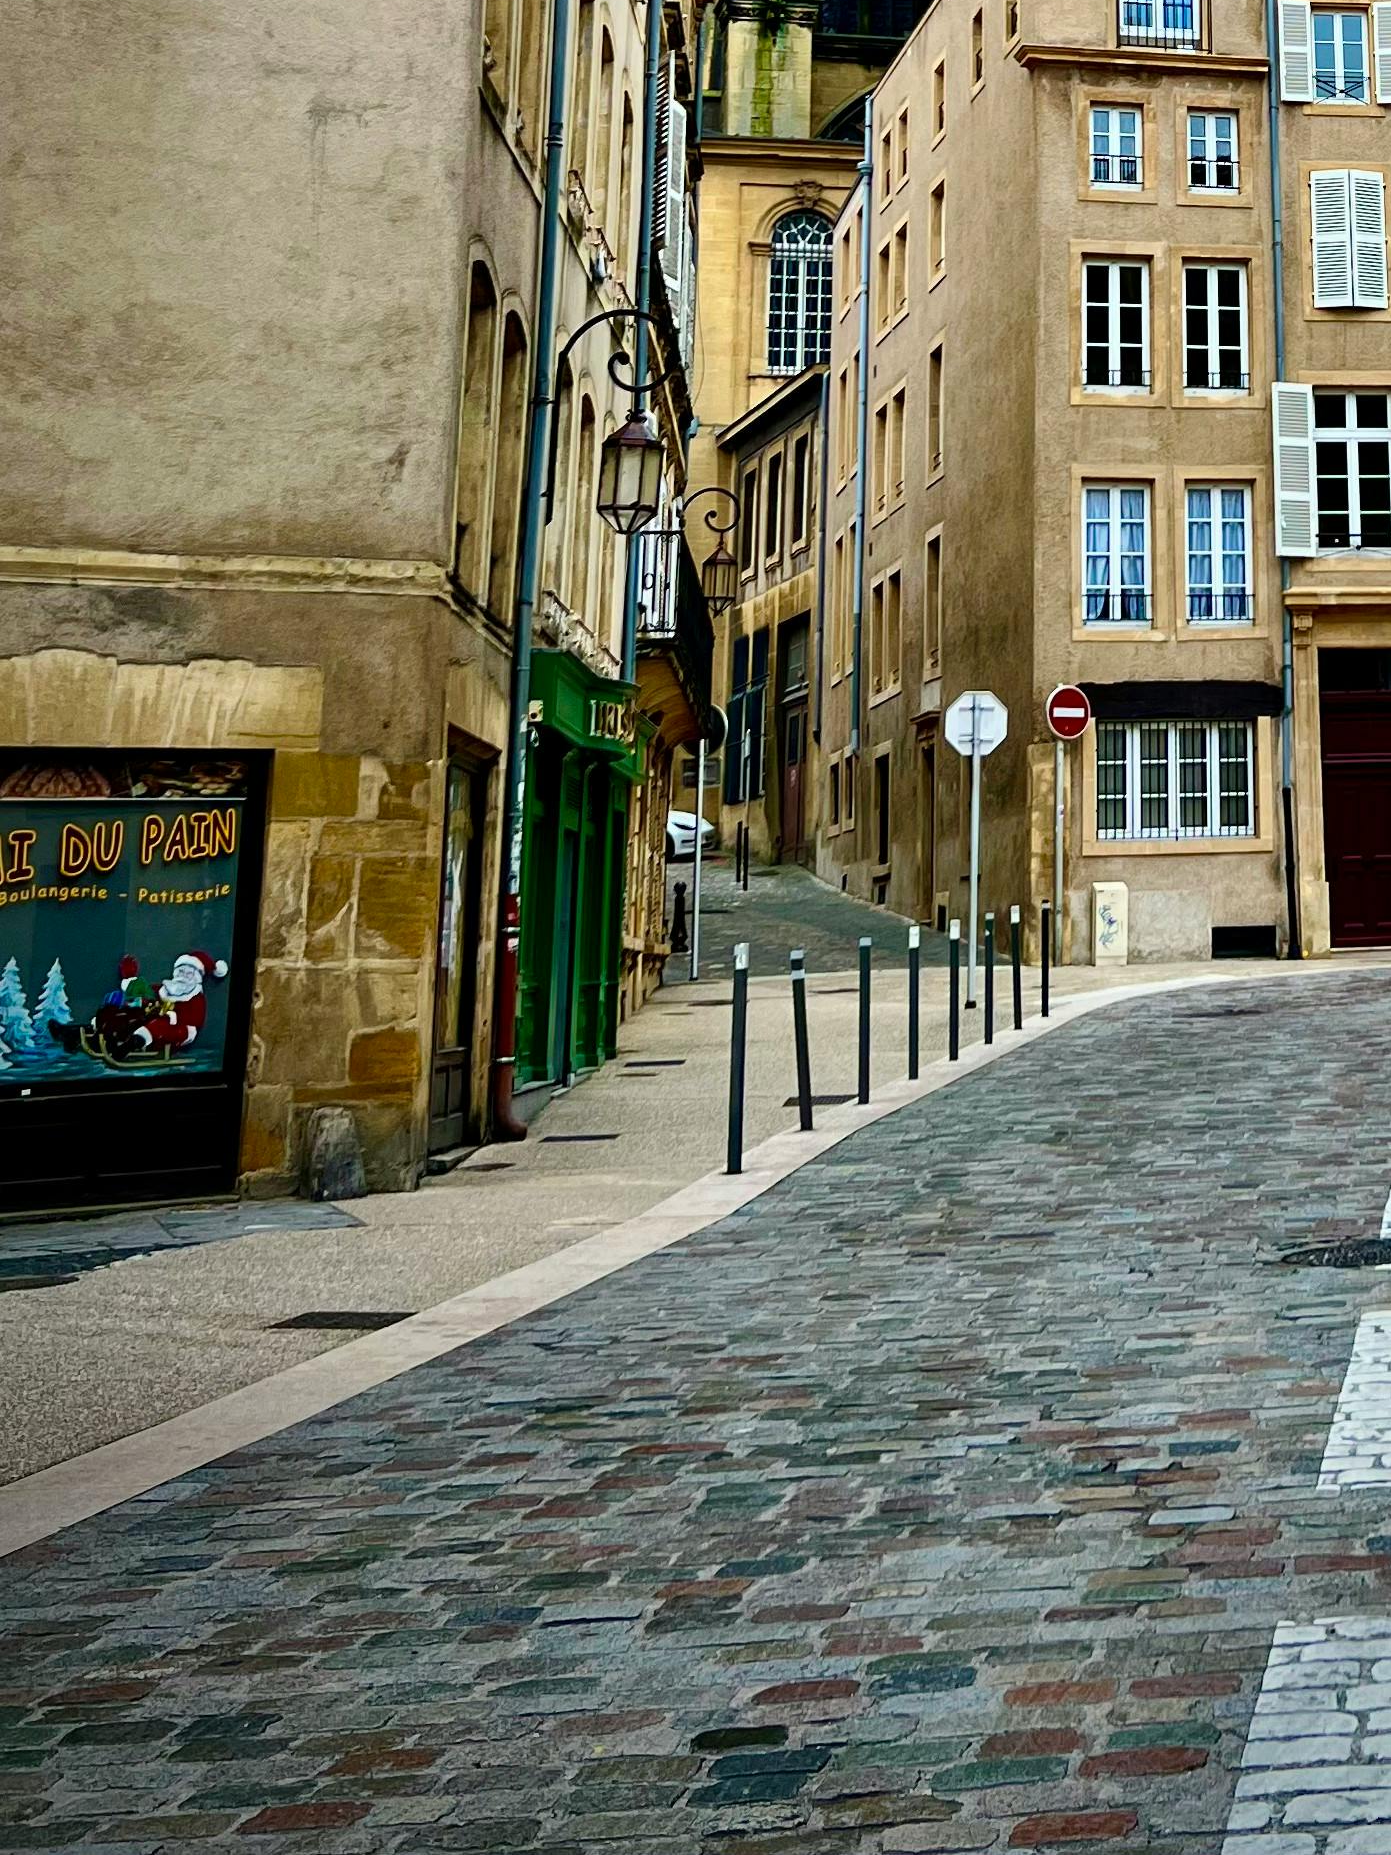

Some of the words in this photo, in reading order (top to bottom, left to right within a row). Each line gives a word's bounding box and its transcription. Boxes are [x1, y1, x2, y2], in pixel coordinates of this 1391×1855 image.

[0, 829, 37, 885] I
[60, 820, 124, 877] DU
[142, 808, 236, 865] PAIN
[0, 884, 108, 906] Boulangerie
[138, 884, 231, 903] Patisserie
